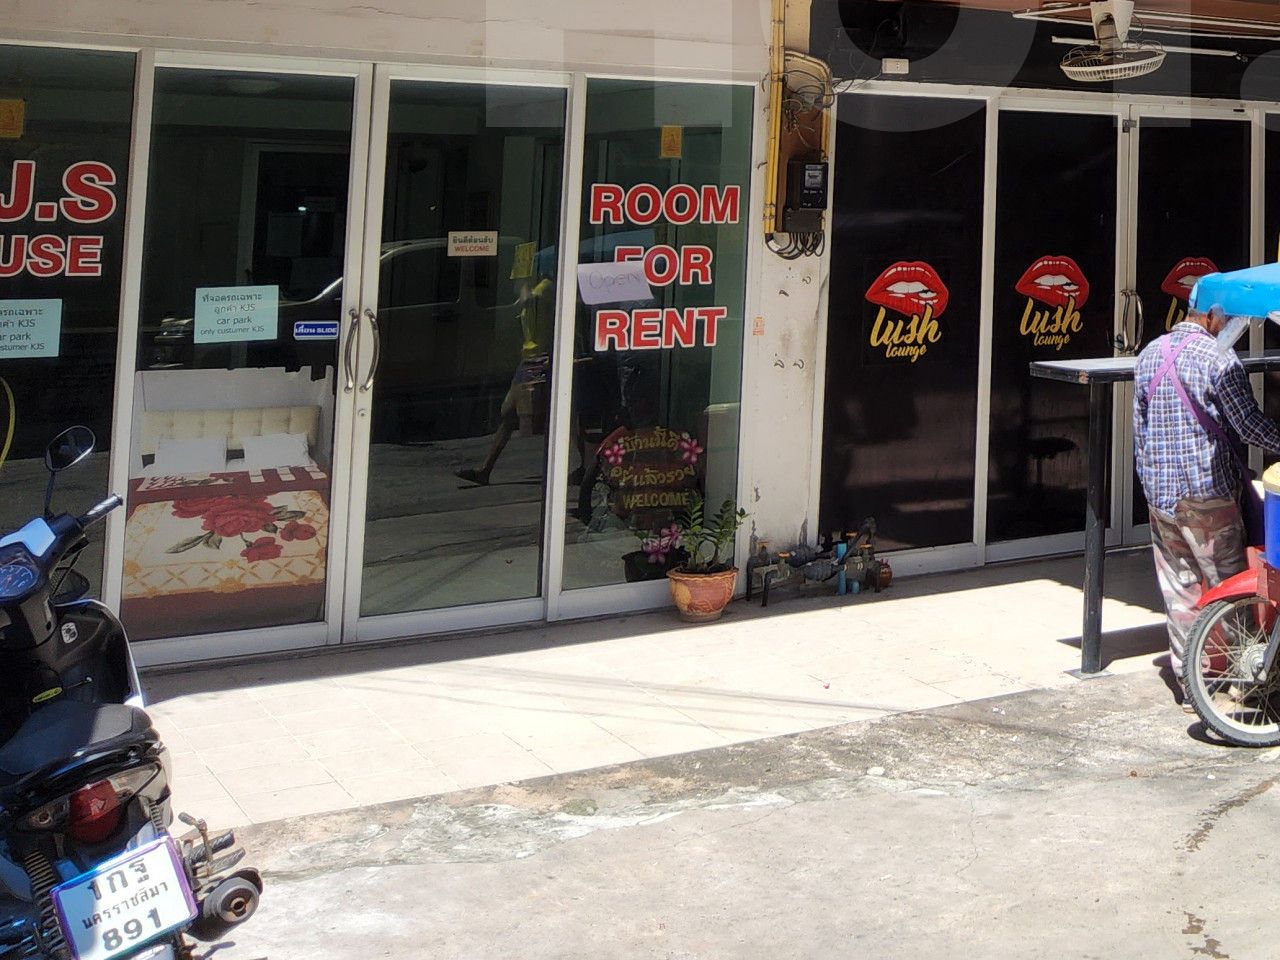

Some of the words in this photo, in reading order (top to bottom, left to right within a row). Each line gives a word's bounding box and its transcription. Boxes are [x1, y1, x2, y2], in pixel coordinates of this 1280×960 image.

[590, 183, 740, 226] ROOM
[240, 303, 256, 311] KJS
[1019, 296, 1084, 337] lush
[18, 319, 36, 328] KJS
[232, 316, 252, 325] park
[595, 307, 727, 351] RENT
[870, 302, 942, 347] lush
[9, 332, 32, 342] park
[1033, 332, 1071, 351] lounge
[886, 341, 927, 362] lounge
[622, 492, 689, 509] WELCOME
[102, 907, 162, 952] 891
